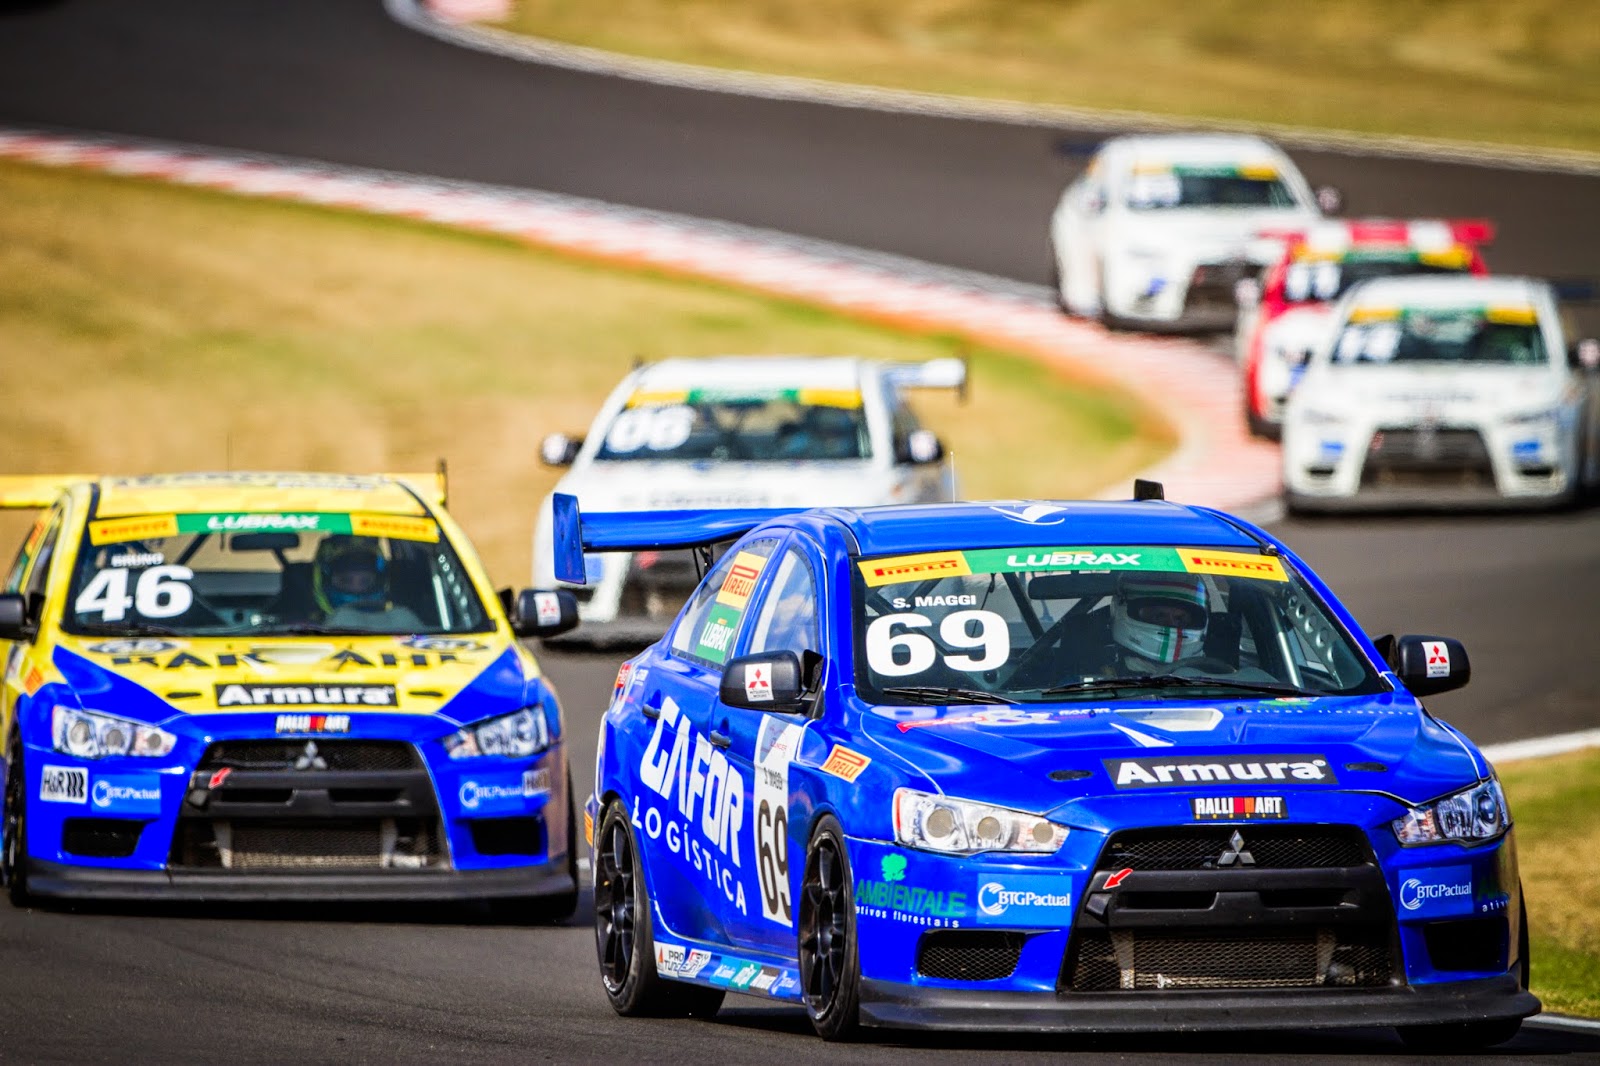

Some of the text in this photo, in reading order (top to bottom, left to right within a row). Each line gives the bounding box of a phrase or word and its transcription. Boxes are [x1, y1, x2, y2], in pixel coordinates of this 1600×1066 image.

[207, 515, 320, 530] LUBRAX
[111, 552, 165, 567] BRUNO
[874, 560, 958, 576] PIRELLI
[1006, 553, 1142, 567] LUBRAX
[1192, 557, 1274, 572] PIRELLI
[722, 564, 759, 597] PIRELLI
[75, 564, 194, 622] 46
[893, 594, 977, 609] S. MAGGI
[865, 610, 1011, 678] 69
[218, 684, 391, 705] Armura
[824, 748, 866, 779] PIRELLI
[1117, 761, 1326, 785] Armura
[631, 795, 747, 916] LOGÍSTICA
[758, 799, 793, 921] 69
[855, 879, 967, 917] AMBIENTALE
[893, 910, 960, 928] florestais
[668, 950, 684, 962] PRO
